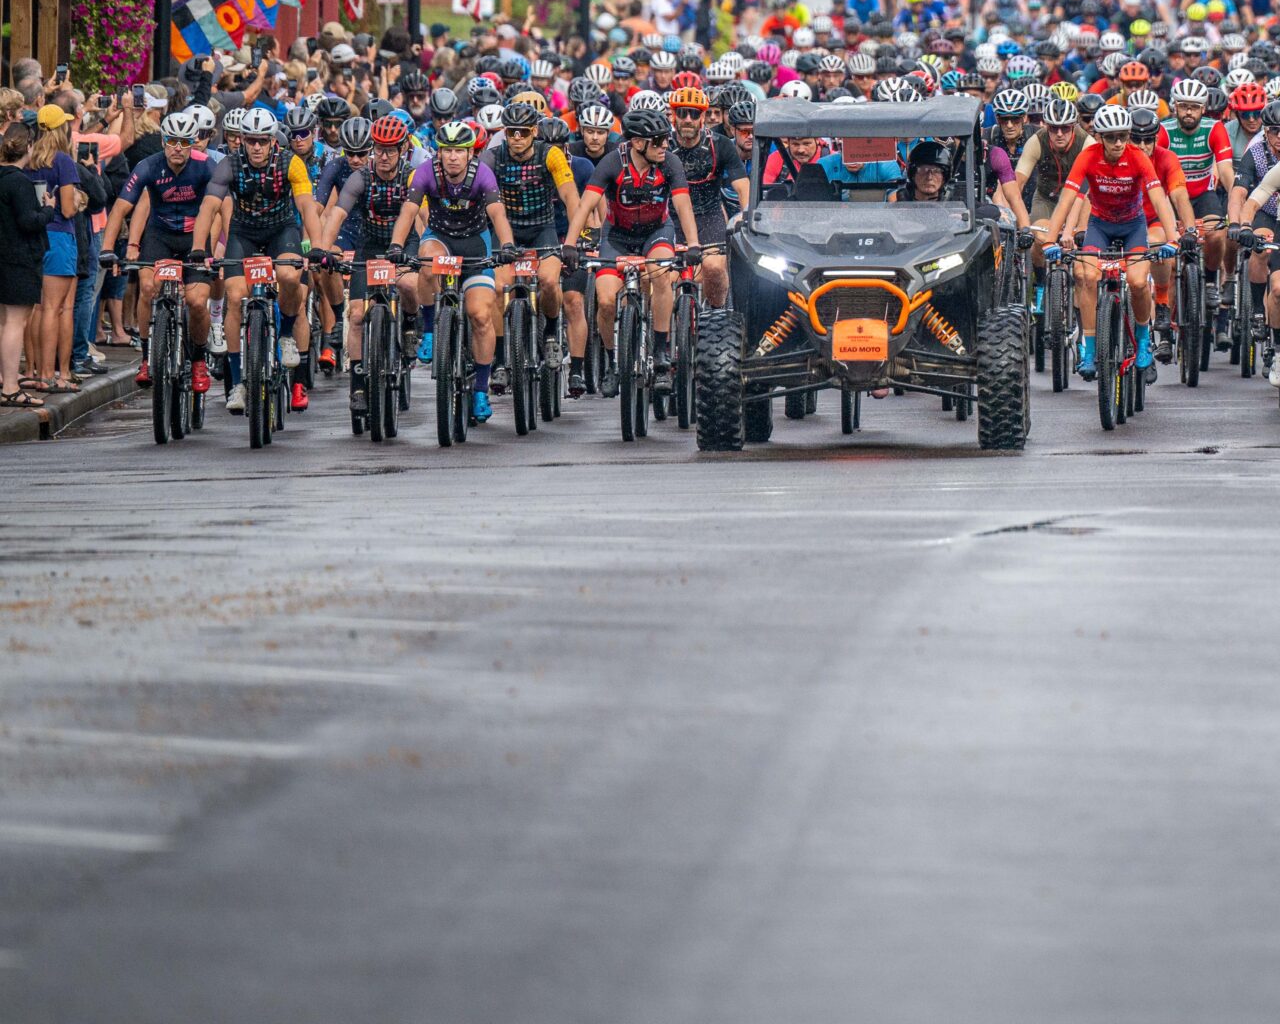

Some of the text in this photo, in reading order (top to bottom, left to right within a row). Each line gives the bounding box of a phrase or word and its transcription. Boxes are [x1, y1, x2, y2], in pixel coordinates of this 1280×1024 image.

[437, 255, 457, 265] 329
[515, 261, 533, 271] 342
[159, 267, 177, 276] 225
[250, 267, 267, 279] 274
[373, 269, 390, 280] 417
